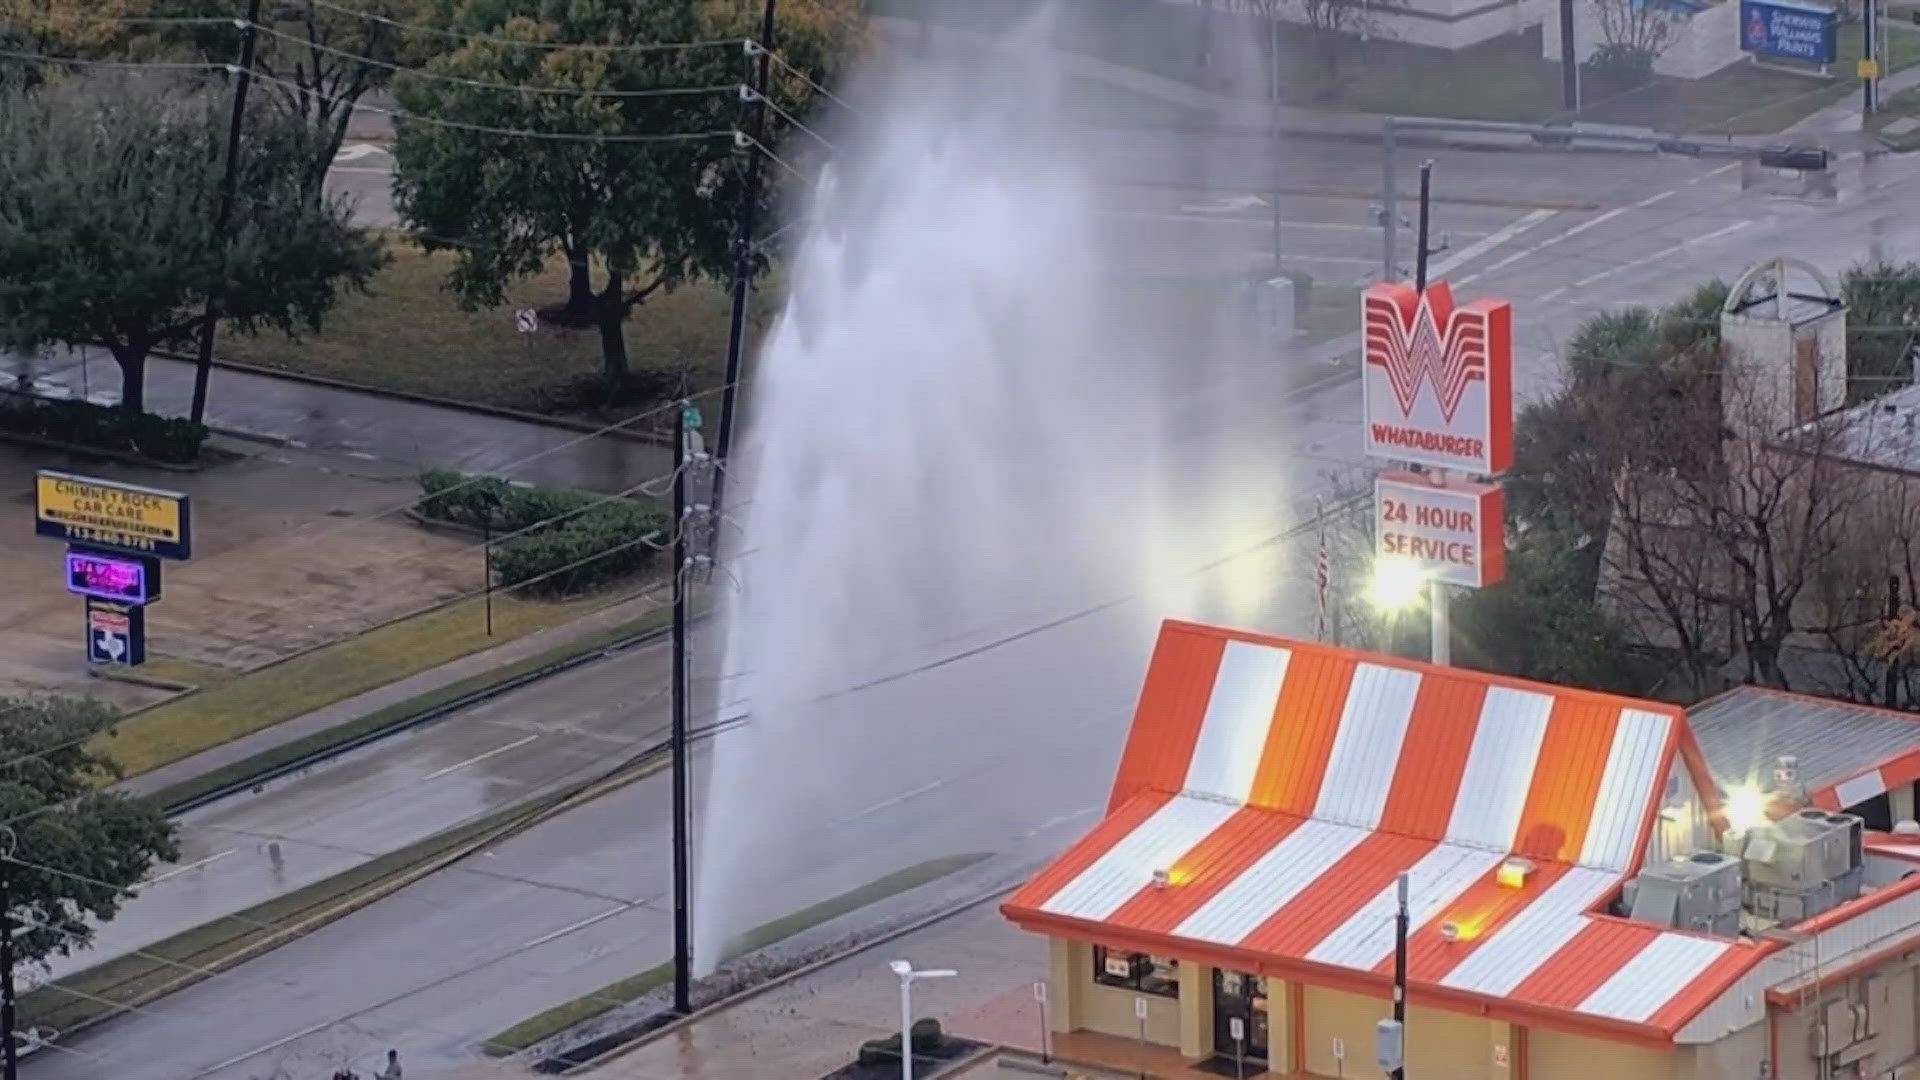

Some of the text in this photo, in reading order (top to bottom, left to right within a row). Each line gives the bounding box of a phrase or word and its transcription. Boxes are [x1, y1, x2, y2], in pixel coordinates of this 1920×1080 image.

[1778, 38, 1815, 56] PAINTS
[1371, 423, 1483, 458] WHATABURGER
[55, 481, 162, 511] CHIMNEY ROCK
[73, 498, 144, 520] CAR CARE
[1383, 500, 1474, 533] 24 HOUR
[1383, 532, 1475, 565] SERVICE
